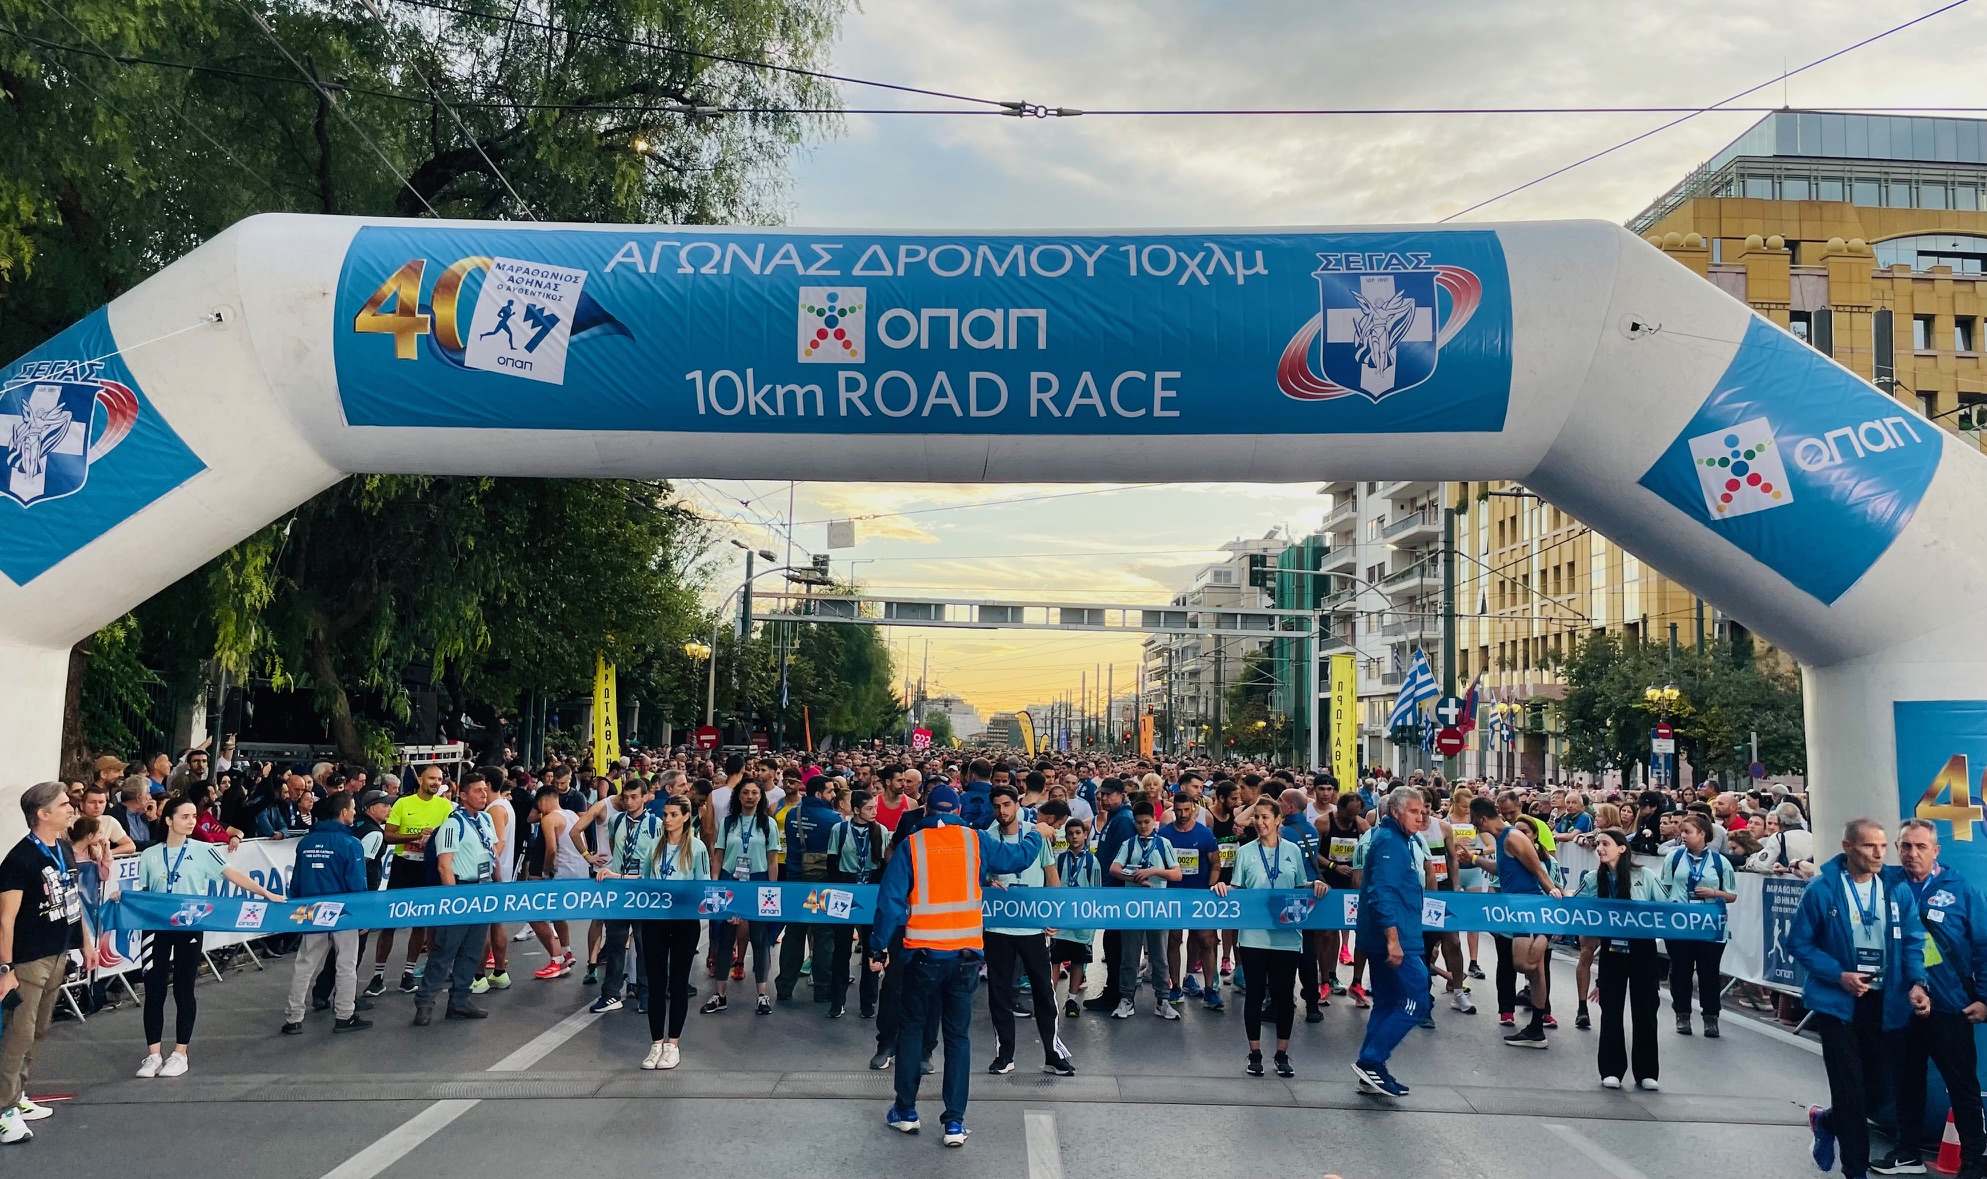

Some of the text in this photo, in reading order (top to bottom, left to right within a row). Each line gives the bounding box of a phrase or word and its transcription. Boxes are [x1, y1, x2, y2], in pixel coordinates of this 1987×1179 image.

[495, 262, 582, 285] ΜΑΡΑΘΩΝΙΟΣ
[603, 241, 1269, 287] ΑΓΩΝΑΣ ΔΡΟΜΟΥ 10χλμ
[1315, 252, 1433, 272] ΣΕΓΑΣ
[505, 285, 565, 302] ΑΥΘΕΝΤΙΚΟΣ
[506, 274, 562, 292] ΑΘΗΝΑΣ
[11, 359, 106, 382] ΣΕΓΑΣ
[685, 367, 1182, 418] 10km ROAD RACE
[603, 661, 612, 777] ΠΡΩΤΑΘΛΗ
[1914, 754, 1987, 842] 4
[388, 891, 673, 918] 10km ROAD RACE OPAP 2023
[982, 900, 1241, 919] ΔΡΟΜΟΥ 10km ΟΠΑΠ 2023
[1481, 905, 1536, 923] 10km
[1540, 907, 1603, 926] ROAD
[1608, 910, 1667, 929] RACE
